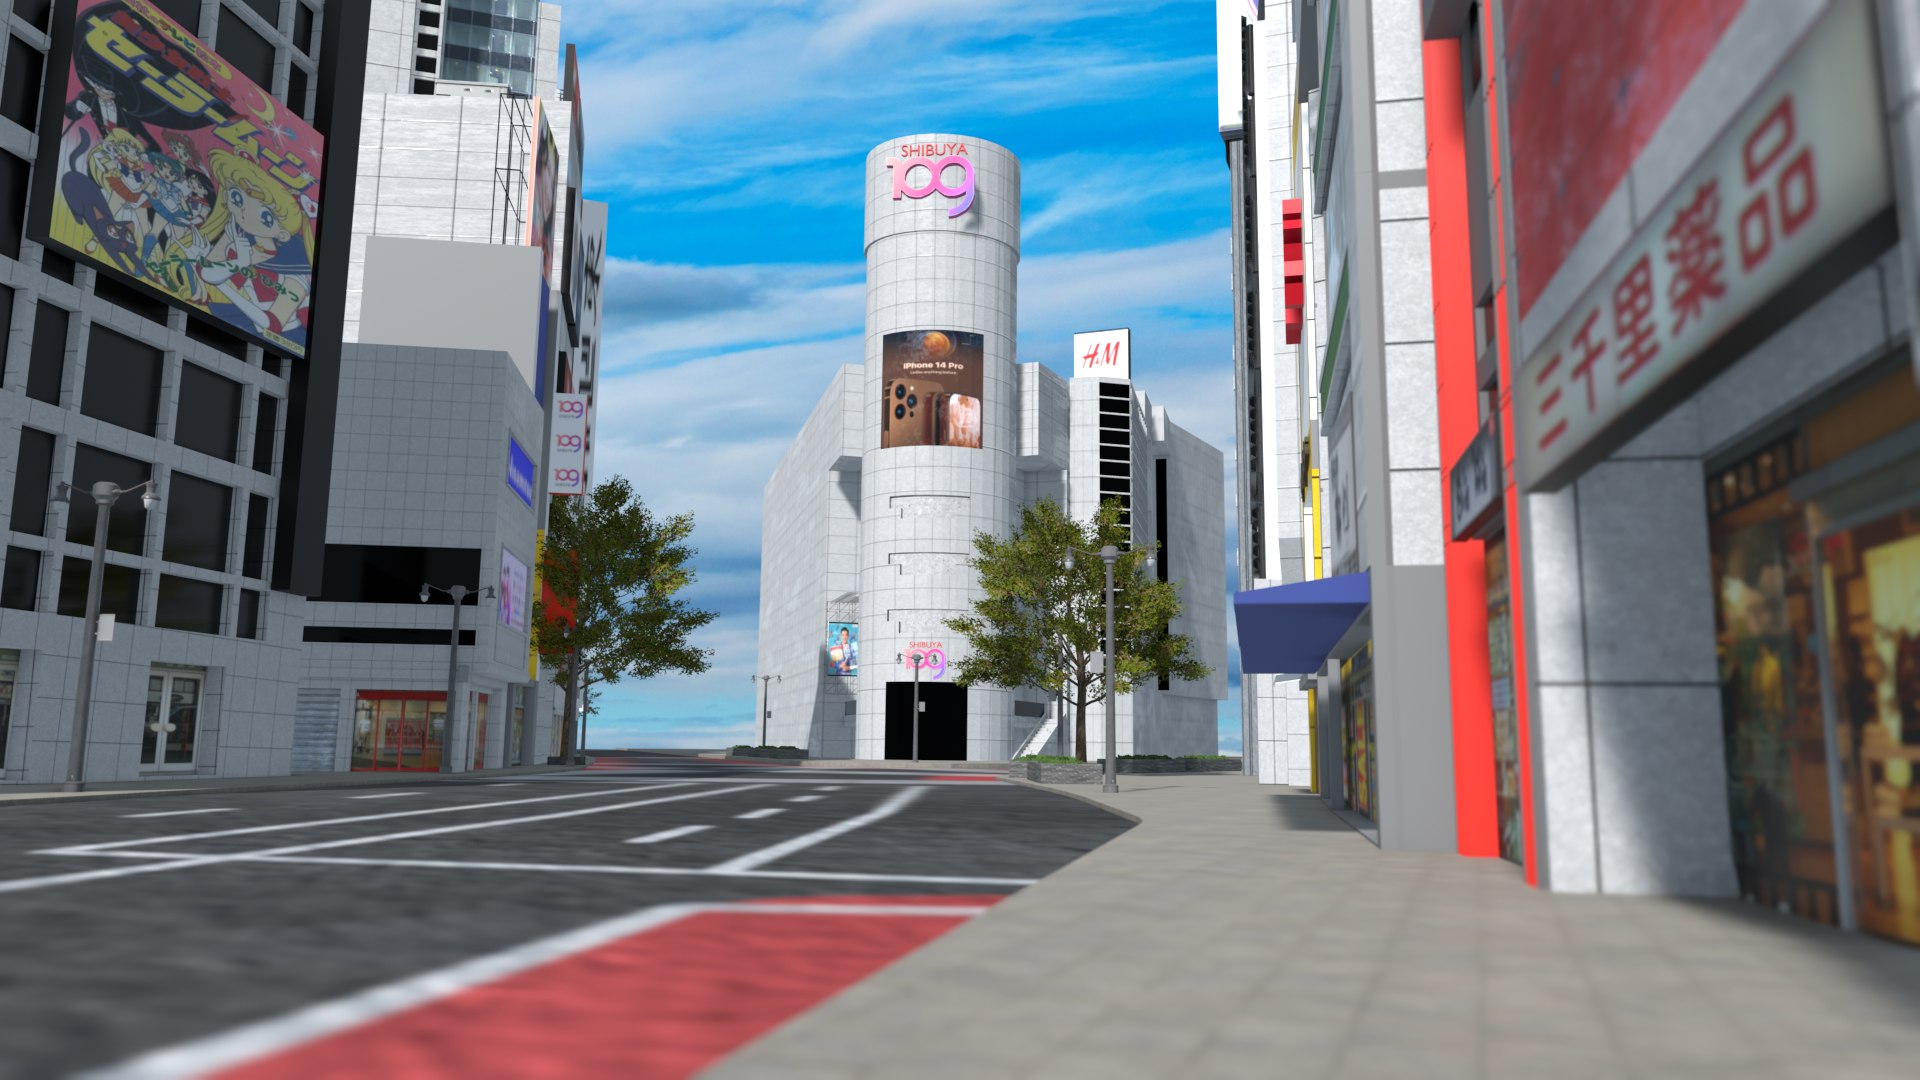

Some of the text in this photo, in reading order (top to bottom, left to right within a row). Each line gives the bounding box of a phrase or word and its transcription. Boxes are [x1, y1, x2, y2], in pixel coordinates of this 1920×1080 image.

[86, 15, 319, 193] セーラームーン
[901, 143, 968, 157] SHIBUYA
[886, 155, 975, 219] 109
[1536, 92, 1819, 452] 三千里薬品
[1082, 341, 1120, 368] H&M
[935, 361, 947, 369] 14
[948, 362, 964, 370] Pro
[558, 400, 583, 419] 109
[556, 434, 581, 453] 109
[554, 468, 579, 487] 109
[909, 641, 943, 649] SHIBUYA
[902, 648, 946, 680] 109
